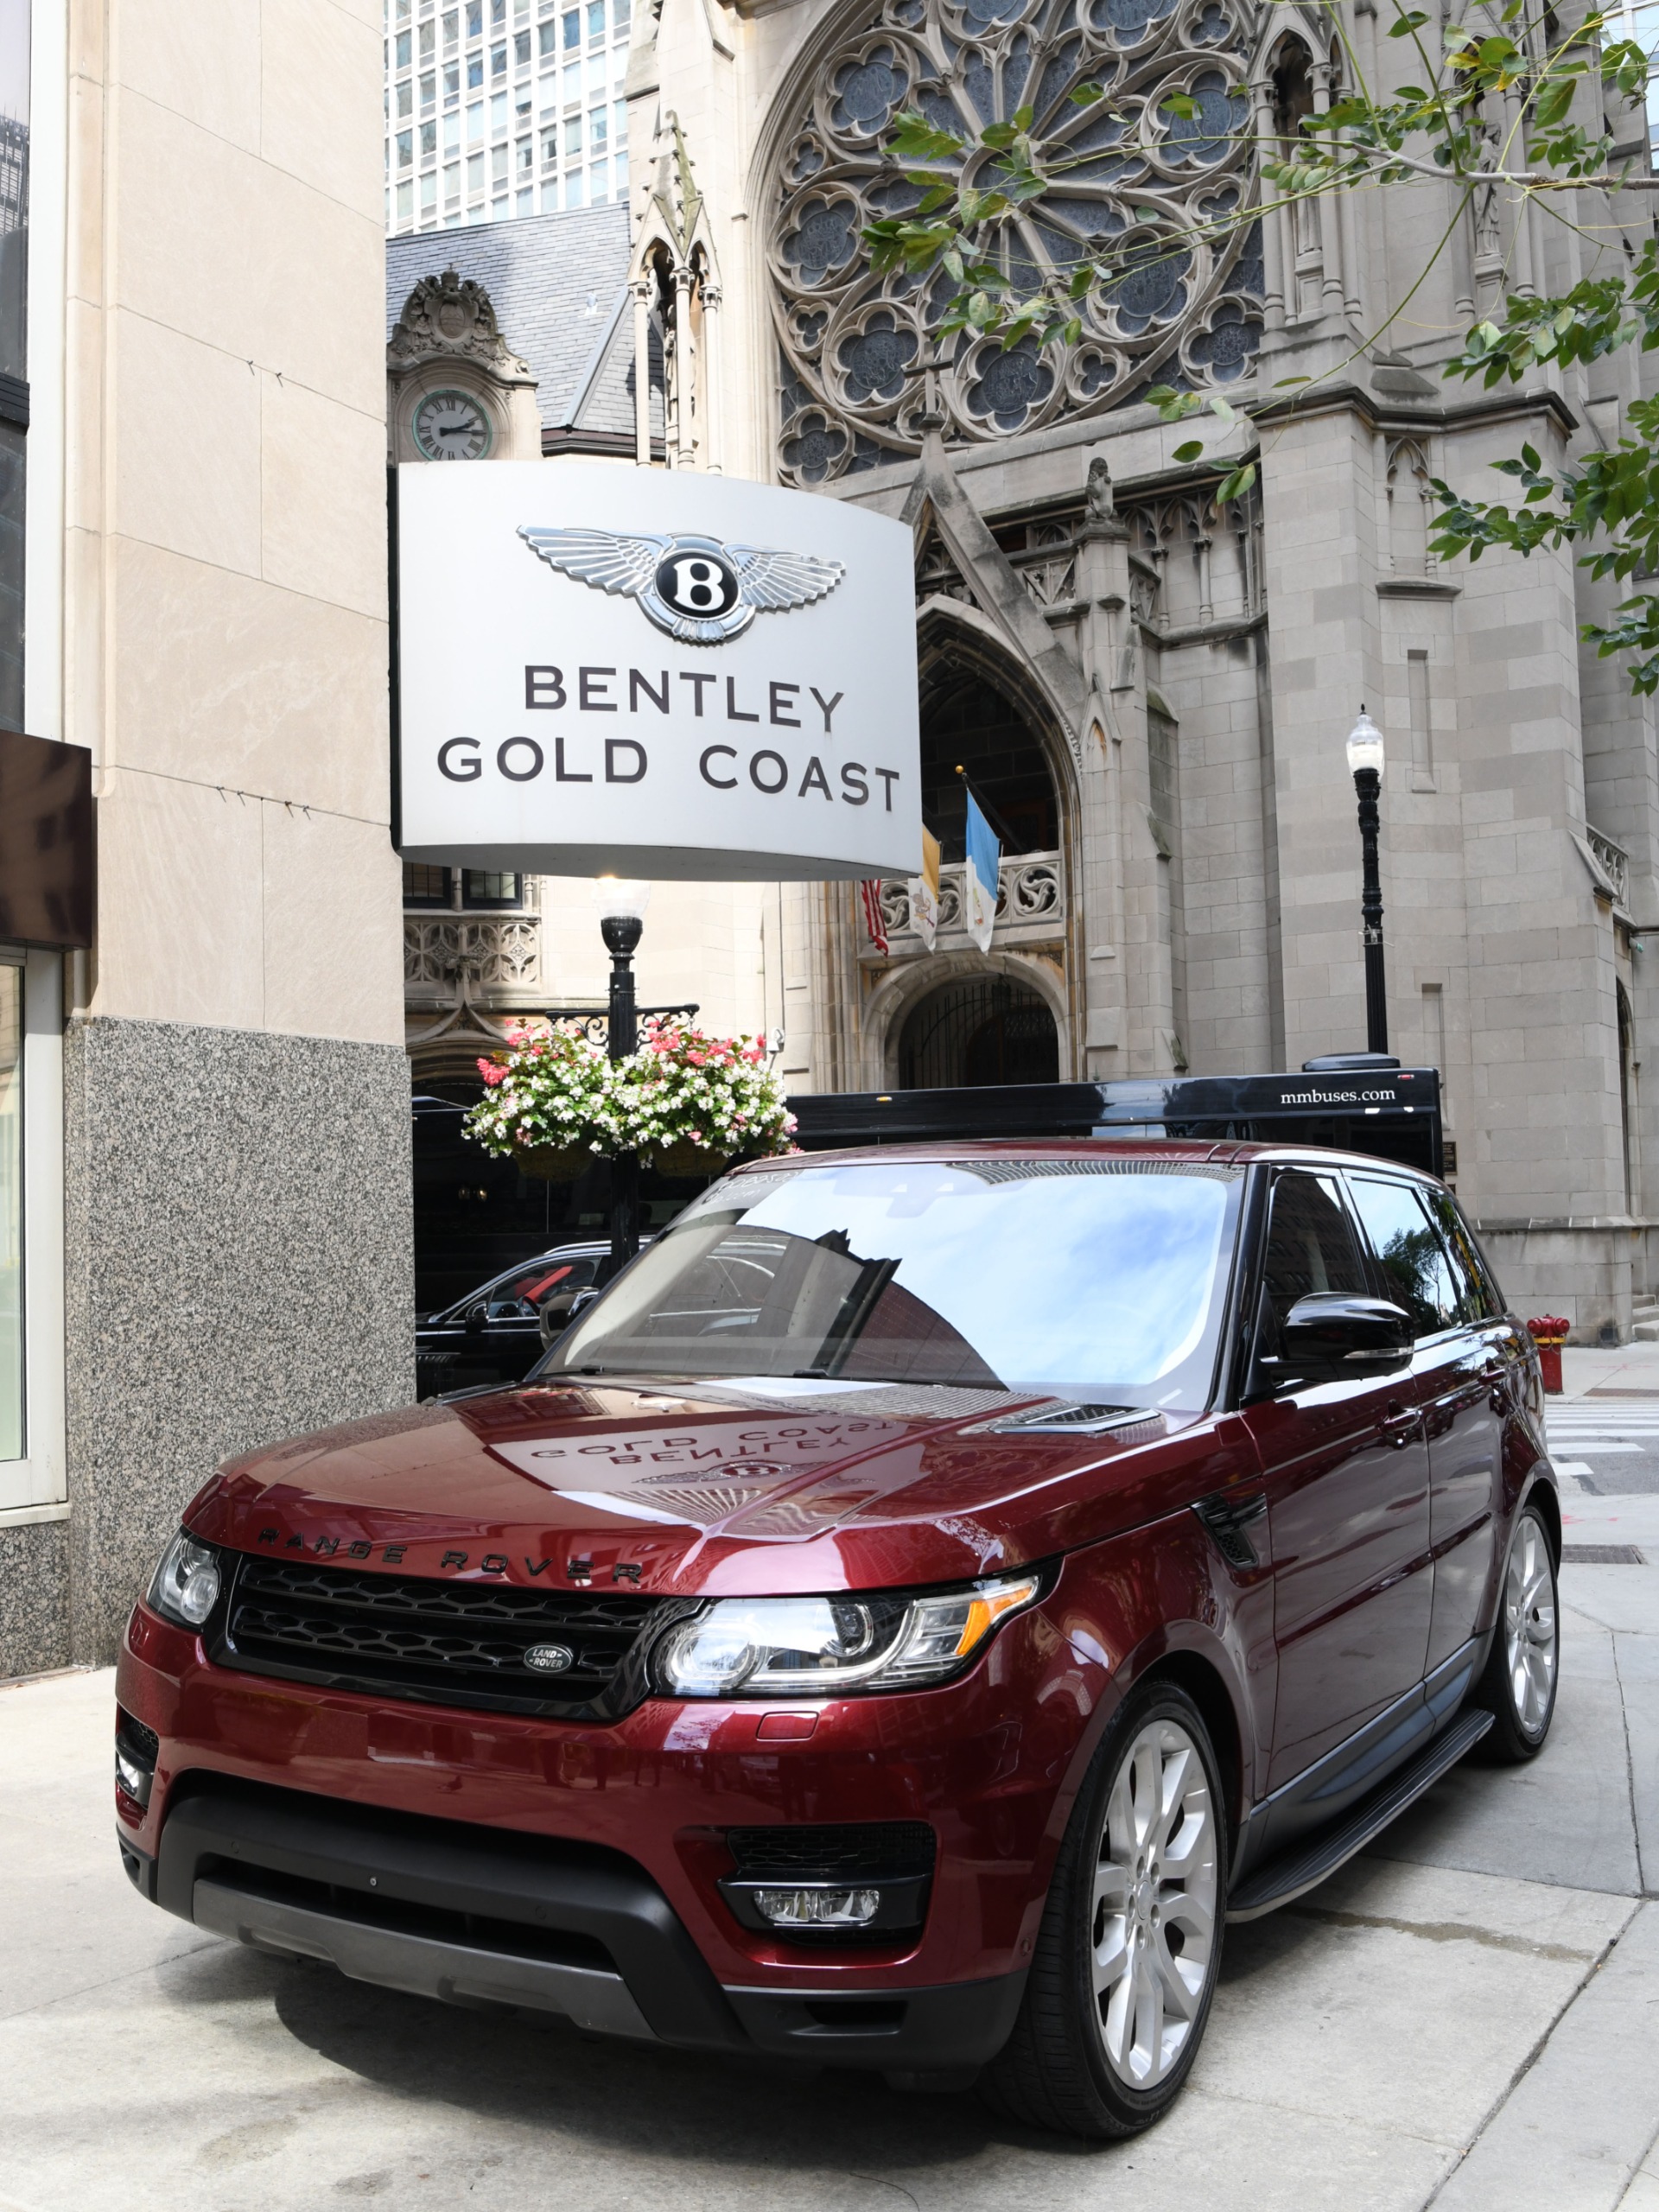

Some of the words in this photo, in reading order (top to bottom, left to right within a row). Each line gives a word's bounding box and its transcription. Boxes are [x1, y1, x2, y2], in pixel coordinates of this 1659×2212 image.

[676, 558, 726, 611] B
[524, 664, 845, 733] BENTLEY
[437, 736, 648, 783] GOLD
[699, 744, 900, 811] COAST
[1281, 1089, 1395, 1103] mmbuses.com
[257, 1528, 408, 1564] RANGE
[441, 1550, 643, 1584] ROVER
[532, 1648, 557, 1658] LAND
[533, 1656, 563, 1669] ROVER
